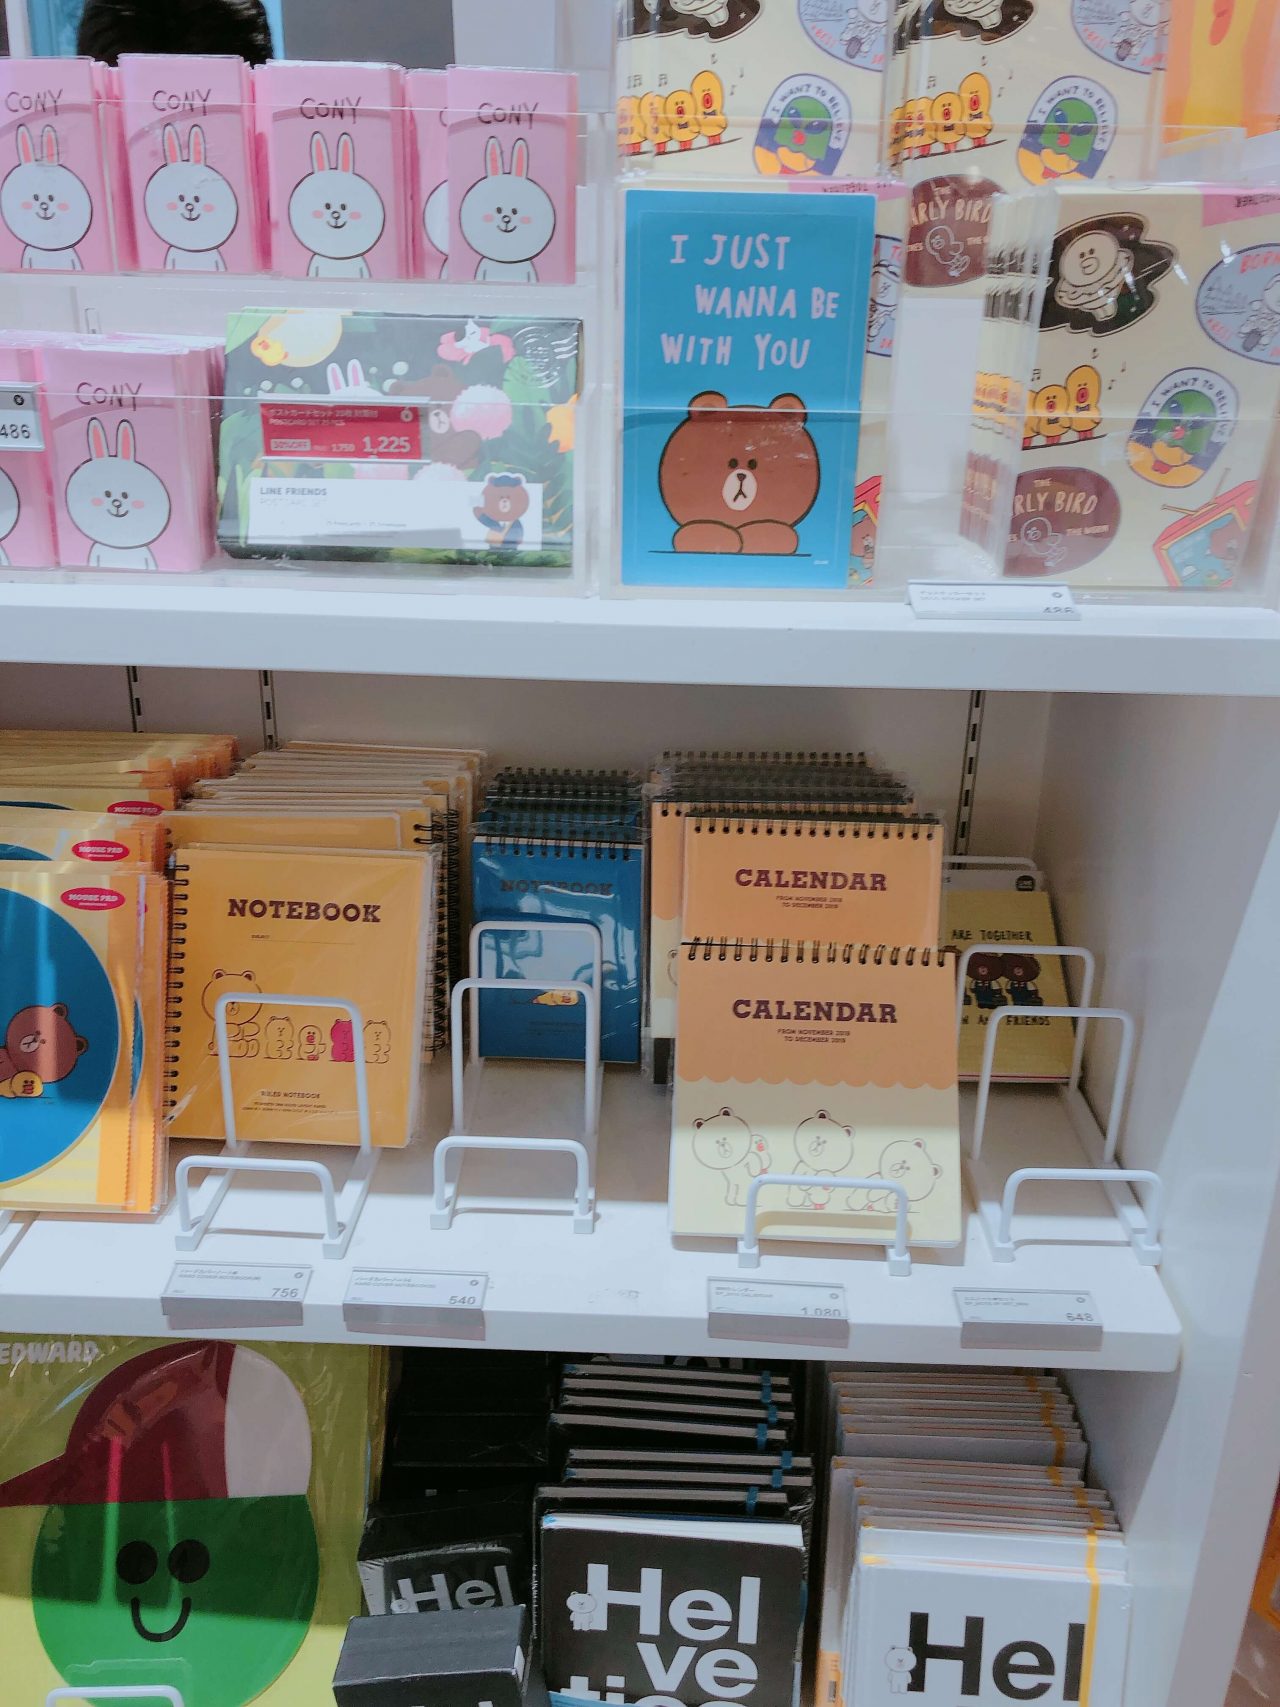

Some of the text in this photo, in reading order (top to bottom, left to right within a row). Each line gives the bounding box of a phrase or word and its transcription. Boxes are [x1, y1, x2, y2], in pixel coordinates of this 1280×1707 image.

[7, 89, 63, 115] CONY
[153, 88, 212, 116] CONY
[300, 97, 362, 124] CONY
[477, 102, 538, 129] CONY
[670, 233, 791, 270] I JUST
[695, 284, 840, 319] WANNA BE
[660, 333, 811, 371] WITH YOU
[76, 382, 142, 412] CONY
[1202, 379, 1214, 391] TO
[0, 423, 31, 439] 486
[362, 435, 411, 453] 1,225
[260, 486, 328, 497] LINE FRIENDS
[1013, 491, 1098, 516] RLY BIRD
[501, 879, 614, 896] NOTEBOOK
[735, 869, 887, 892] CALENDAR
[227, 898, 381, 923] NOTEBOOK
[952, 929, 1033, 942] ARE TOGETHER
[732, 999, 897, 1023] CALENDAR
[1006, 1014, 1051, 1026] FRIENDS
[271, 1287, 300, 1298] 756
[448, 1295, 476, 1305] 540
[0, 1341, 99, 1364] EDWARD
[396, 1565, 515, 1614] Hel
[587, 1563, 761, 1645] Hel
[908, 1611, 1086, 1702] Hel
[636, 1641, 758, 1699] ve
